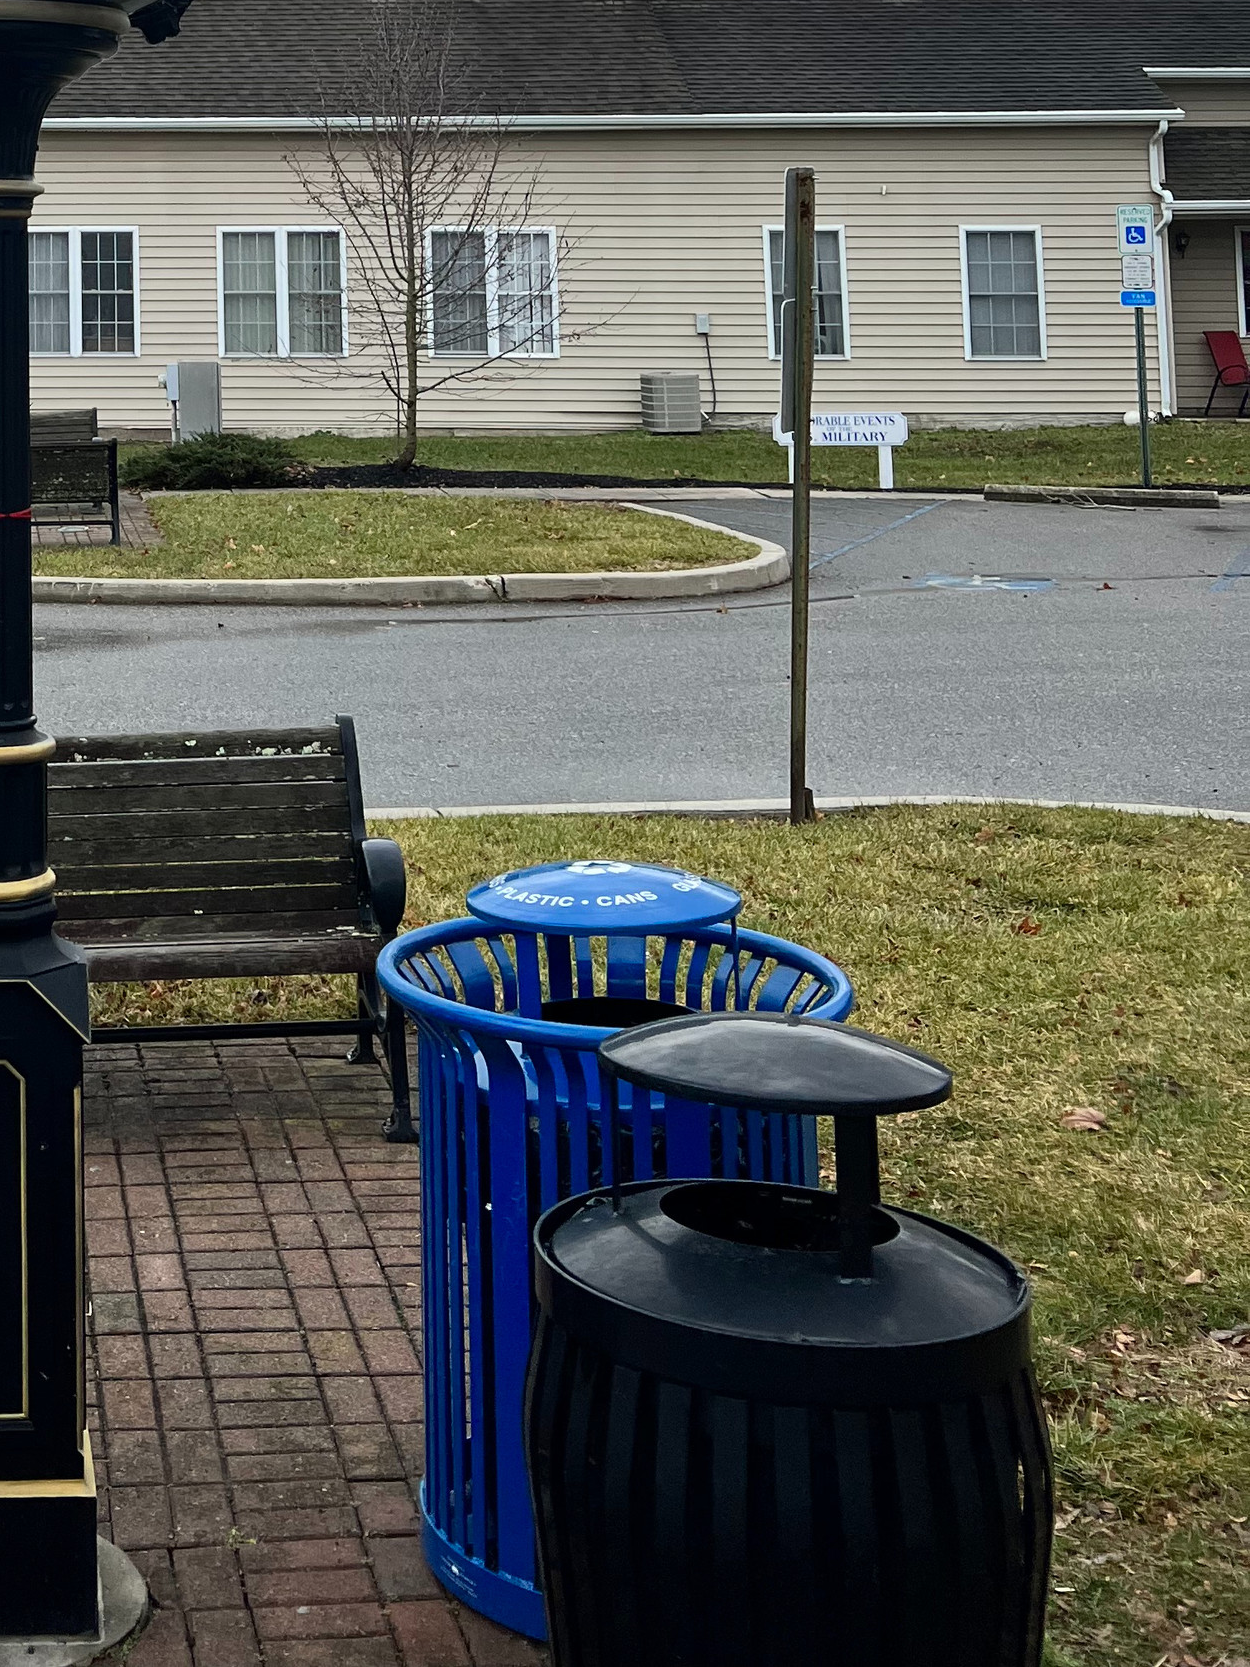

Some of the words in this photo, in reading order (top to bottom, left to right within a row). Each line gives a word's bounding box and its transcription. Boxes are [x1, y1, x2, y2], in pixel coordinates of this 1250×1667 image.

[853, 415, 896, 426] EVENTS
[822, 432, 888, 442] MILITARY
[496, 887, 575, 907] PLASTIC
[596, 890, 659, 907] CANS
